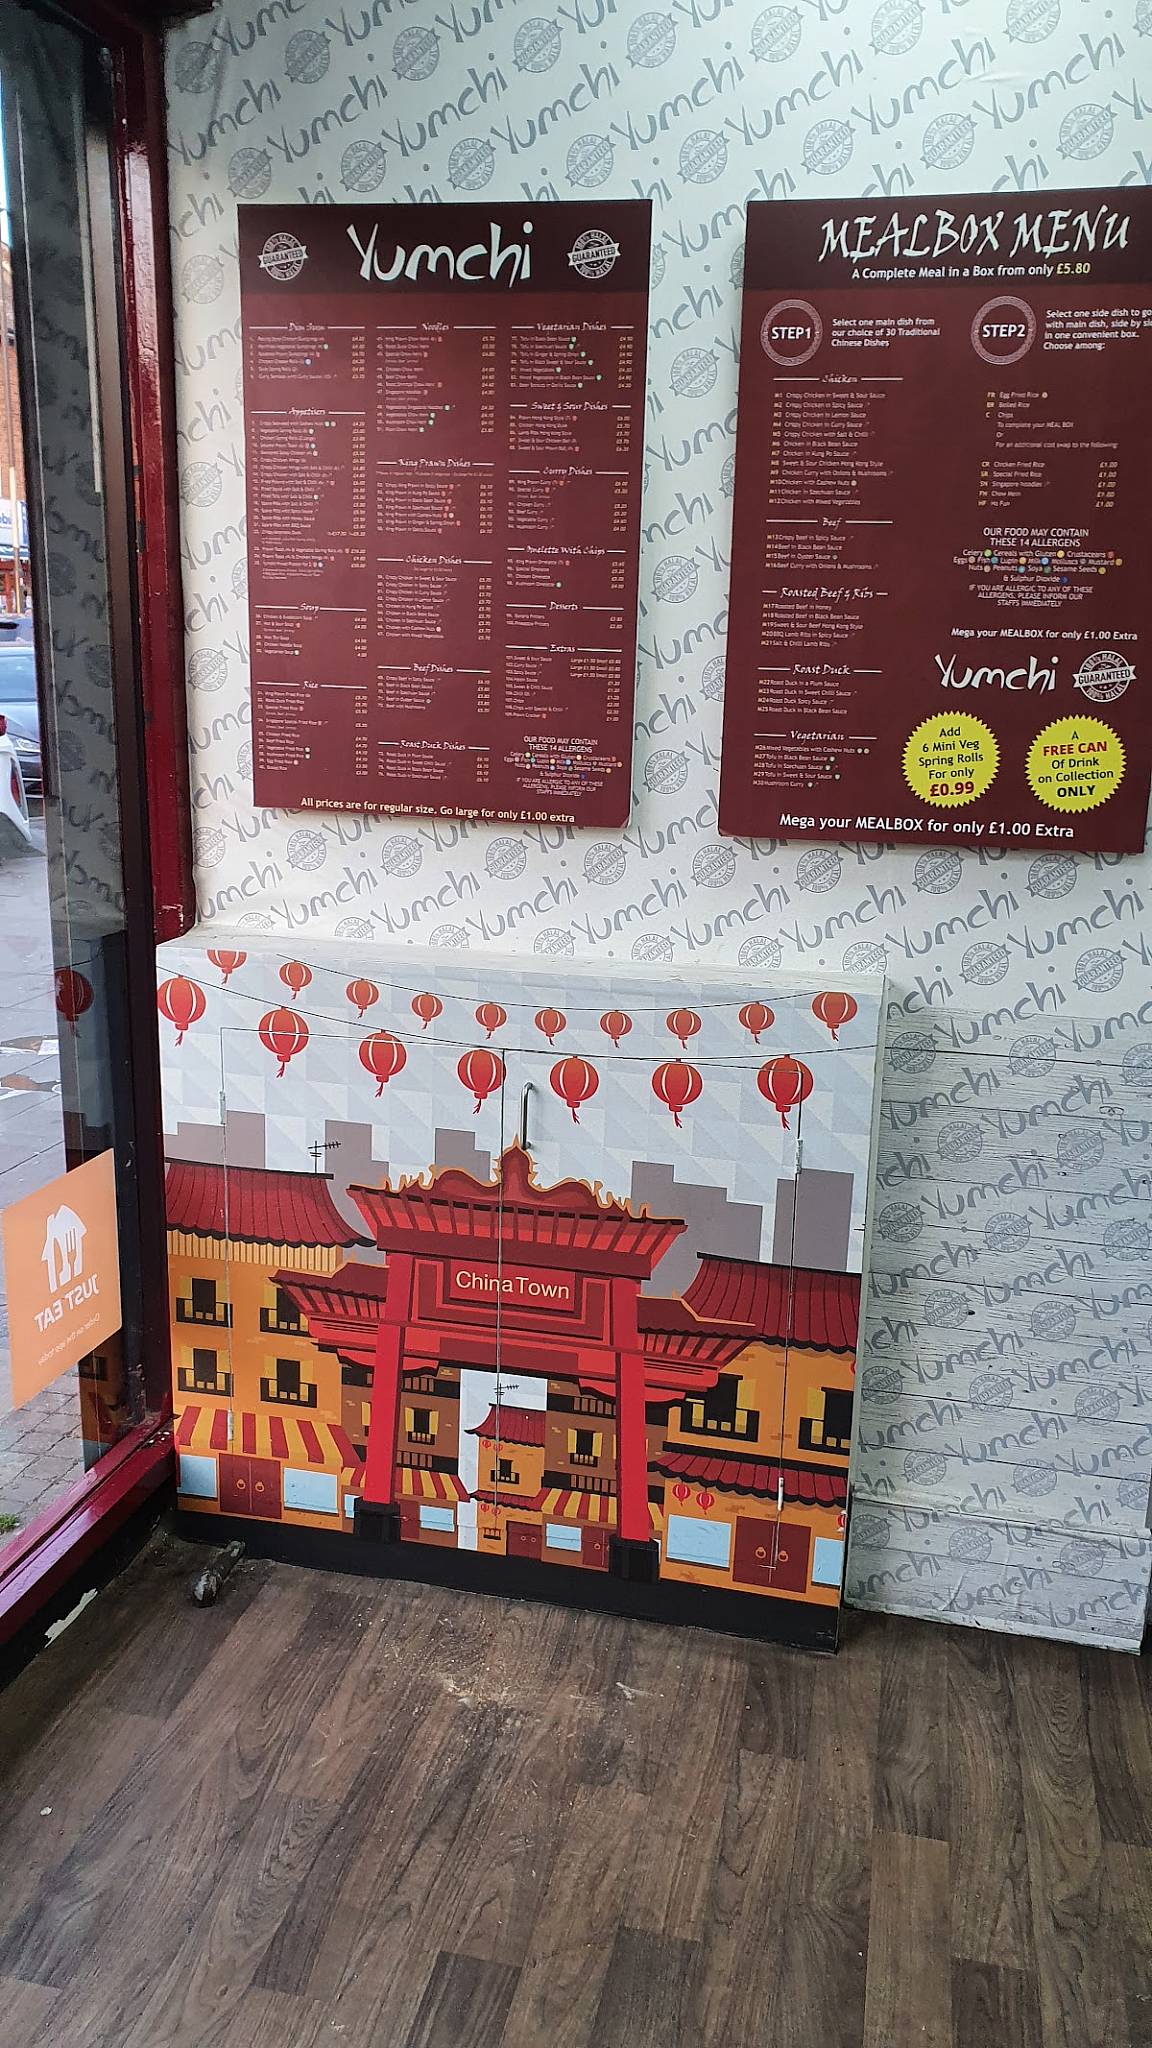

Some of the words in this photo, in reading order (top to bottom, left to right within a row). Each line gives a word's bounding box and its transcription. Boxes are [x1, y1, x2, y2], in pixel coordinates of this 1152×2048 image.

[972, 10, 1125, 129] Yumchi
[725, 27, 863, 146] Yumchi
[382, 53, 507, 157] Yumchi
[818, 209, 1004, 263] MEALBOX
[1010, 204, 1131, 259] MENU
[346, 221, 533, 288] Yumchi
[852, 268, 860, 279] A
[863, 267, 916, 280] Complete
[919, 266, 945, 278] Meal
[949, 266, 960, 277] in
[963, 269, 969, 277] a
[973, 265, 994, 276] Box
[997, 264, 1025, 276] from
[1028, 264, 1054, 278] only
[1057, 262, 1090, 275] £5.80
[1046, 310, 1072, 318] Select
[1092, 309, 1109, 317] side
[1142, 310, 1152, 318] go
[537, 322, 580, 335] Vegetarian
[582, 321, 607, 331] Dishes
[1066, 320, 1086, 328] main
[1130, 319, 1141, 329] by
[772, 327, 811, 339] STEP1
[898, 328, 940, 336] Traditional
[982, 325, 1026, 337] STEP2
[1044, 331, 1052, 339] in
[1043, 342, 1073, 350] Choose
[822, 373, 858, 383] Chicken
[583, 401, 608, 411] Dishes
[447, 458, 471, 467] Dishes
[568, 466, 593, 475] Dishes
[822, 518, 842, 529] Beef
[983, 528, 1002, 536] OUR
[1004, 528, 1029, 536] FOOD
[1031, 528, 1048, 536] MAY
[1050, 529, 1089, 537] CONTAIN
[991, 538, 1017, 546] THESE
[1020, 538, 1029, 546] 14
[1031, 538, 1081, 547] ALLERGENS
[406, 555, 437, 563] Chicken
[438, 556, 461, 564] Dishes
[780, 587, 819, 600] Roasted
[821, 588, 844, 603] Beef
[852, 587, 873, 599] Ribs
[550, 602, 578, 611] Desserts
[951, 628, 974, 638] Mega
[977, 629, 997, 639] your
[1000, 628, 1043, 638] MEALBOX
[1045, 629, 1058, 638] for
[1061, 631, 1081, 641] only
[1084, 631, 1111, 640] £1.00
[1113, 631, 1137, 640] Extra
[413, 663, 431, 675] Beef
[432, 663, 453, 673] Dishes
[792, 664, 820, 674] Roast
[822, 664, 851, 675] Duck
[934, 654, 1059, 695] Yumchi
[1078, 669, 1130, 684] GUARANTEED
[790, 731, 844, 744] Vegetarian
[939, 727, 961, 737] Add
[1071, 731, 1079, 740] A
[444, 741, 465, 750] Dishes
[558, 745, 592, 753] ALLERGENS
[922, 744, 928, 752] 6
[932, 741, 954, 752] Mini
[957, 740, 980, 753] Veg
[1043, 743, 1074, 756] FREE
[1077, 741, 1107, 754] CAN
[918, 756, 955, 769] Spring
[957, 753, 984, 763] Rolls
[1052, 758, 1065, 768] Of
[1067, 756, 1099, 768] Drink
[928, 769, 946, 780] For
[950, 768, 975, 780] only
[1038, 775, 1051, 784] on
[1055, 769, 1113, 782] Collection
[930, 782, 974, 797] £0.99
[1056, 785, 1096, 798] ONLY
[301, 798, 313, 807] All
[316, 799, 343, 810] prices
[346, 801, 361, 809] are
[364, 800, 377, 810] for
[380, 803, 412, 813] regular
[415, 803, 437, 814] size.
[440, 806, 453, 815] Go
[456, 807, 479, 818] large
[481, 807, 495, 817] for
[498, 809, 518, 820] only
[520, 811, 547, 820] £1.00
[550, 813, 574, 822] extra
[780, 813, 815, 831] Mega
[819, 816, 851, 831] your
[855, 816, 923, 831] MEALBOX
[927, 819, 948, 832] for
[953, 820, 984, 836] only
[989, 821, 1031, 835] £1.00
[1036, 825, 1074, 838] Extra
[270, 851, 378, 930] Yumchi
[466, 859, 579, 941] Yumchi
[571, 867, 688, 944] Yumchi
[885, 872, 1020, 959] Yumchi
[1007, 879, 1145, 959] Yumchi
[934, 966, 1066, 1048] Yumchi
